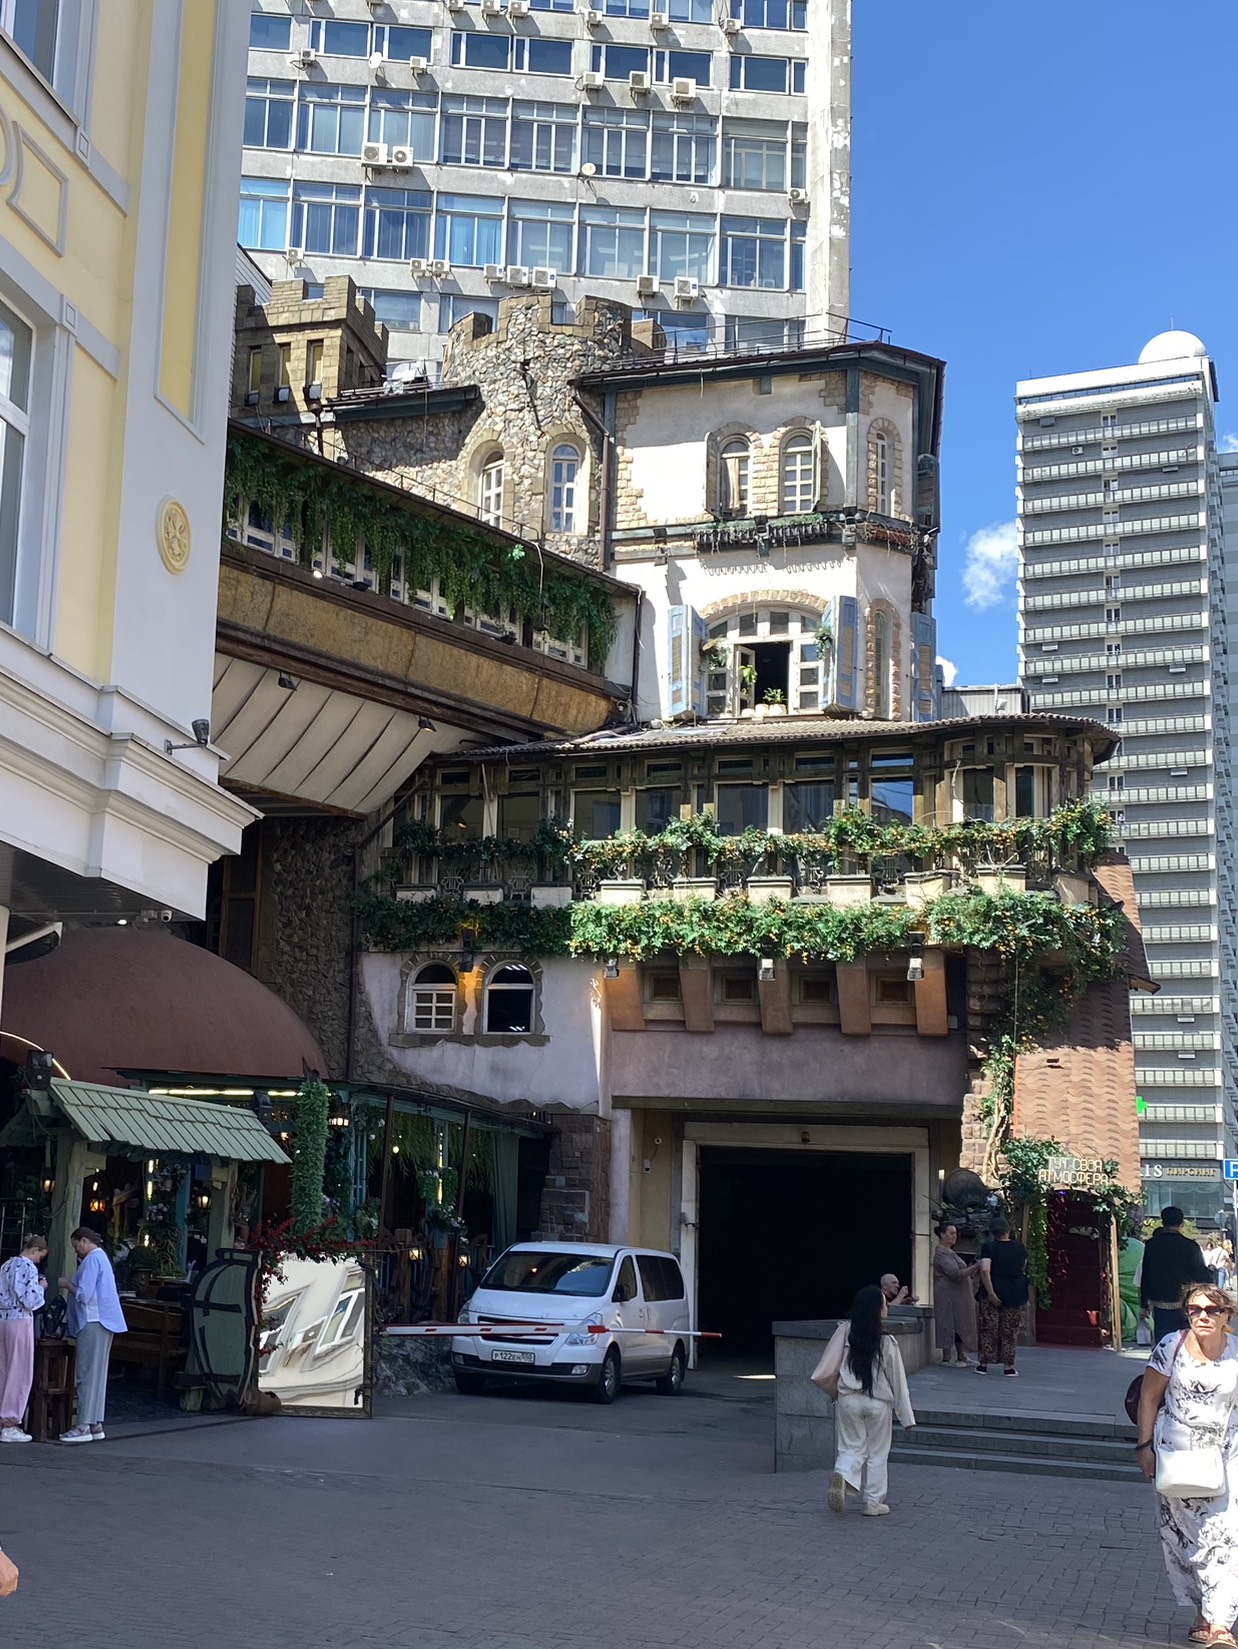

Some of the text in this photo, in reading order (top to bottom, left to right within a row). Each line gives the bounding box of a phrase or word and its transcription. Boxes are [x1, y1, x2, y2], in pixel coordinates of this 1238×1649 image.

[1045, 1156, 1103, 1172] ТУТ СВОЯ
[1141, 1164, 1163, 1178] IS
[1039, 1169, 1109, 1186] АТМОСФЕРА
[1167, 1167, 1216, 1177] ПИРСИНГ
